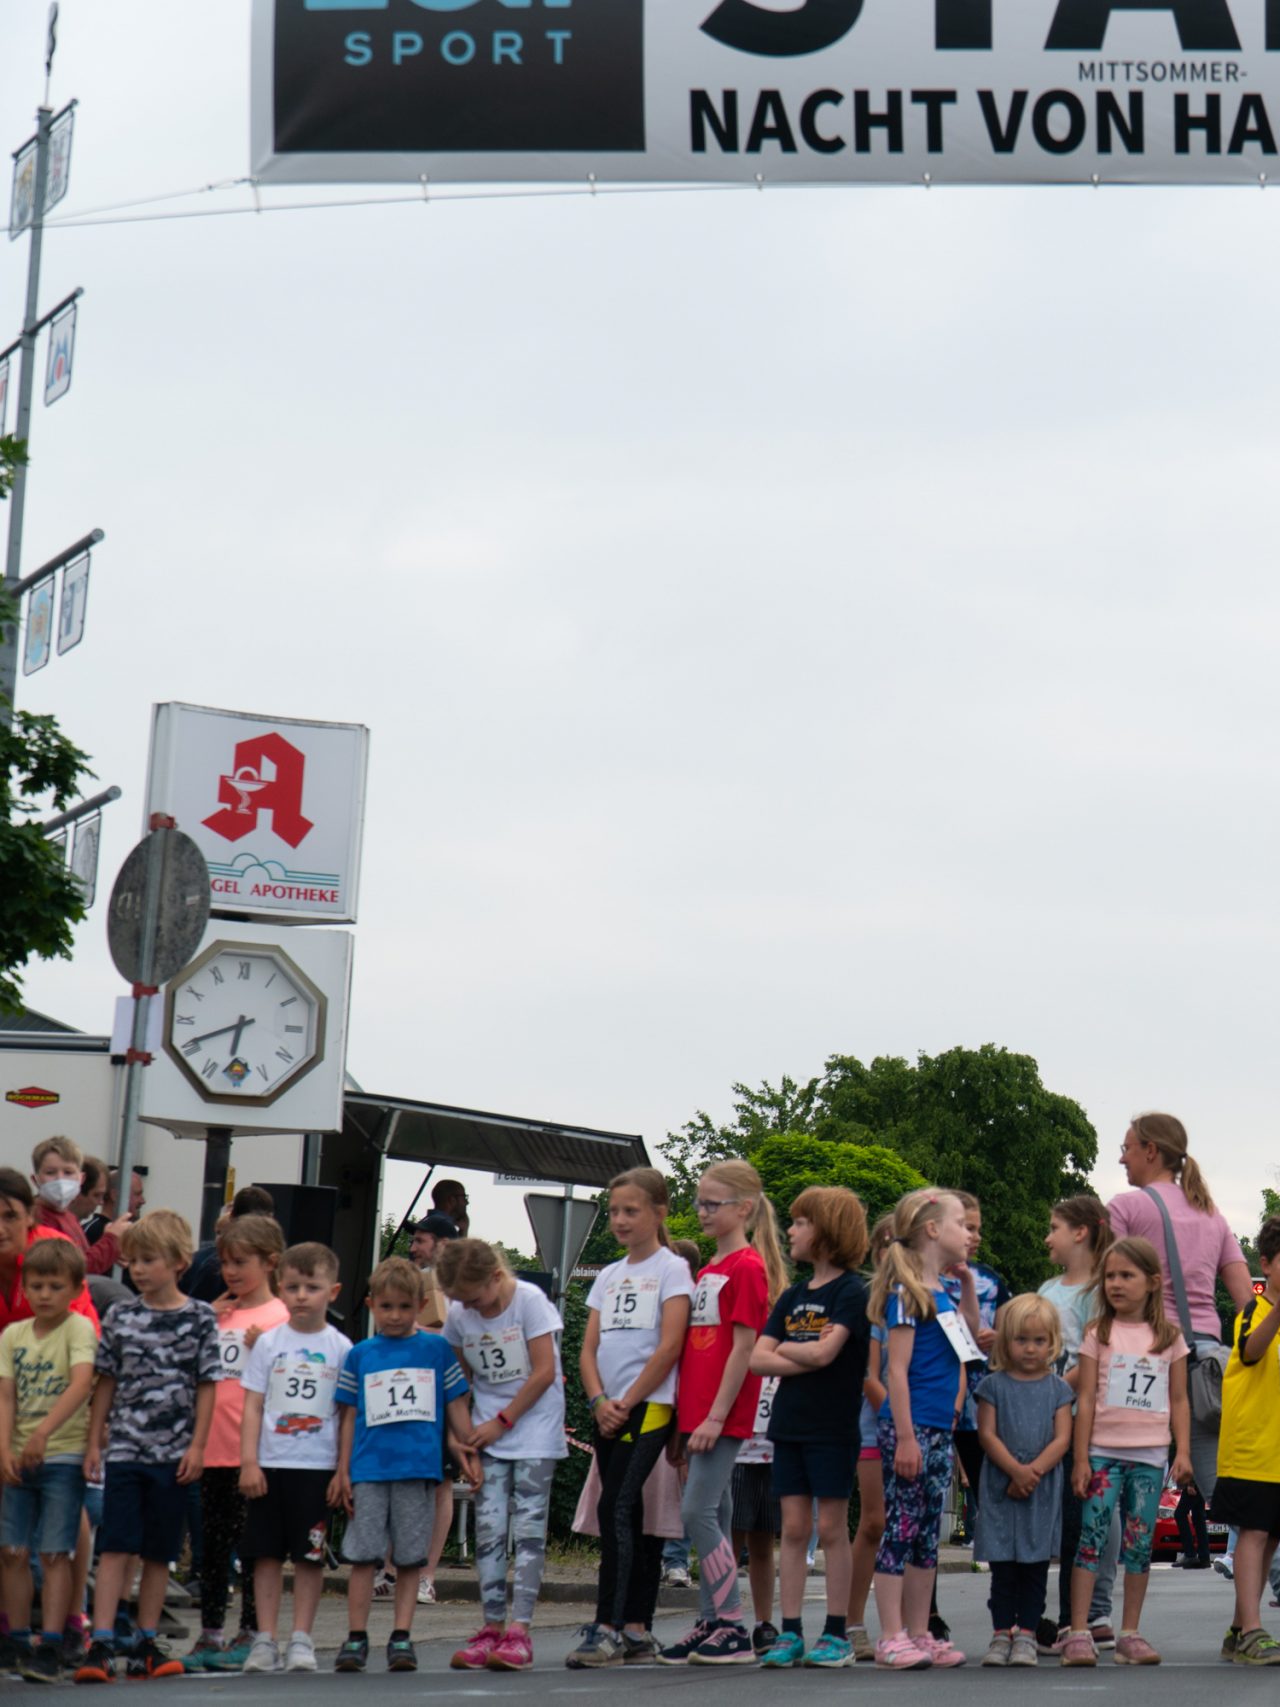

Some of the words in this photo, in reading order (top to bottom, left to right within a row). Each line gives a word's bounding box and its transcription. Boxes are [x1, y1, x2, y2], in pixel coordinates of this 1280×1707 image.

[343, 31, 572, 67] SPORT
[1077, 60, 1248, 83] MITTSOMMER-
[687, 88, 957, 154] NACHT
[976, 89, 1145, 155] VON
[250, 883, 340, 903] APOTHEKE
[613, 1293, 638, 1314] 15
[478, 1347, 507, 1370] 13
[285, 1377, 318, 1400] 35
[387, 1384, 418, 1407] 14
[1127, 1372, 1157, 1396] 17
[1125, 1395, 1152, 1408] Frida
